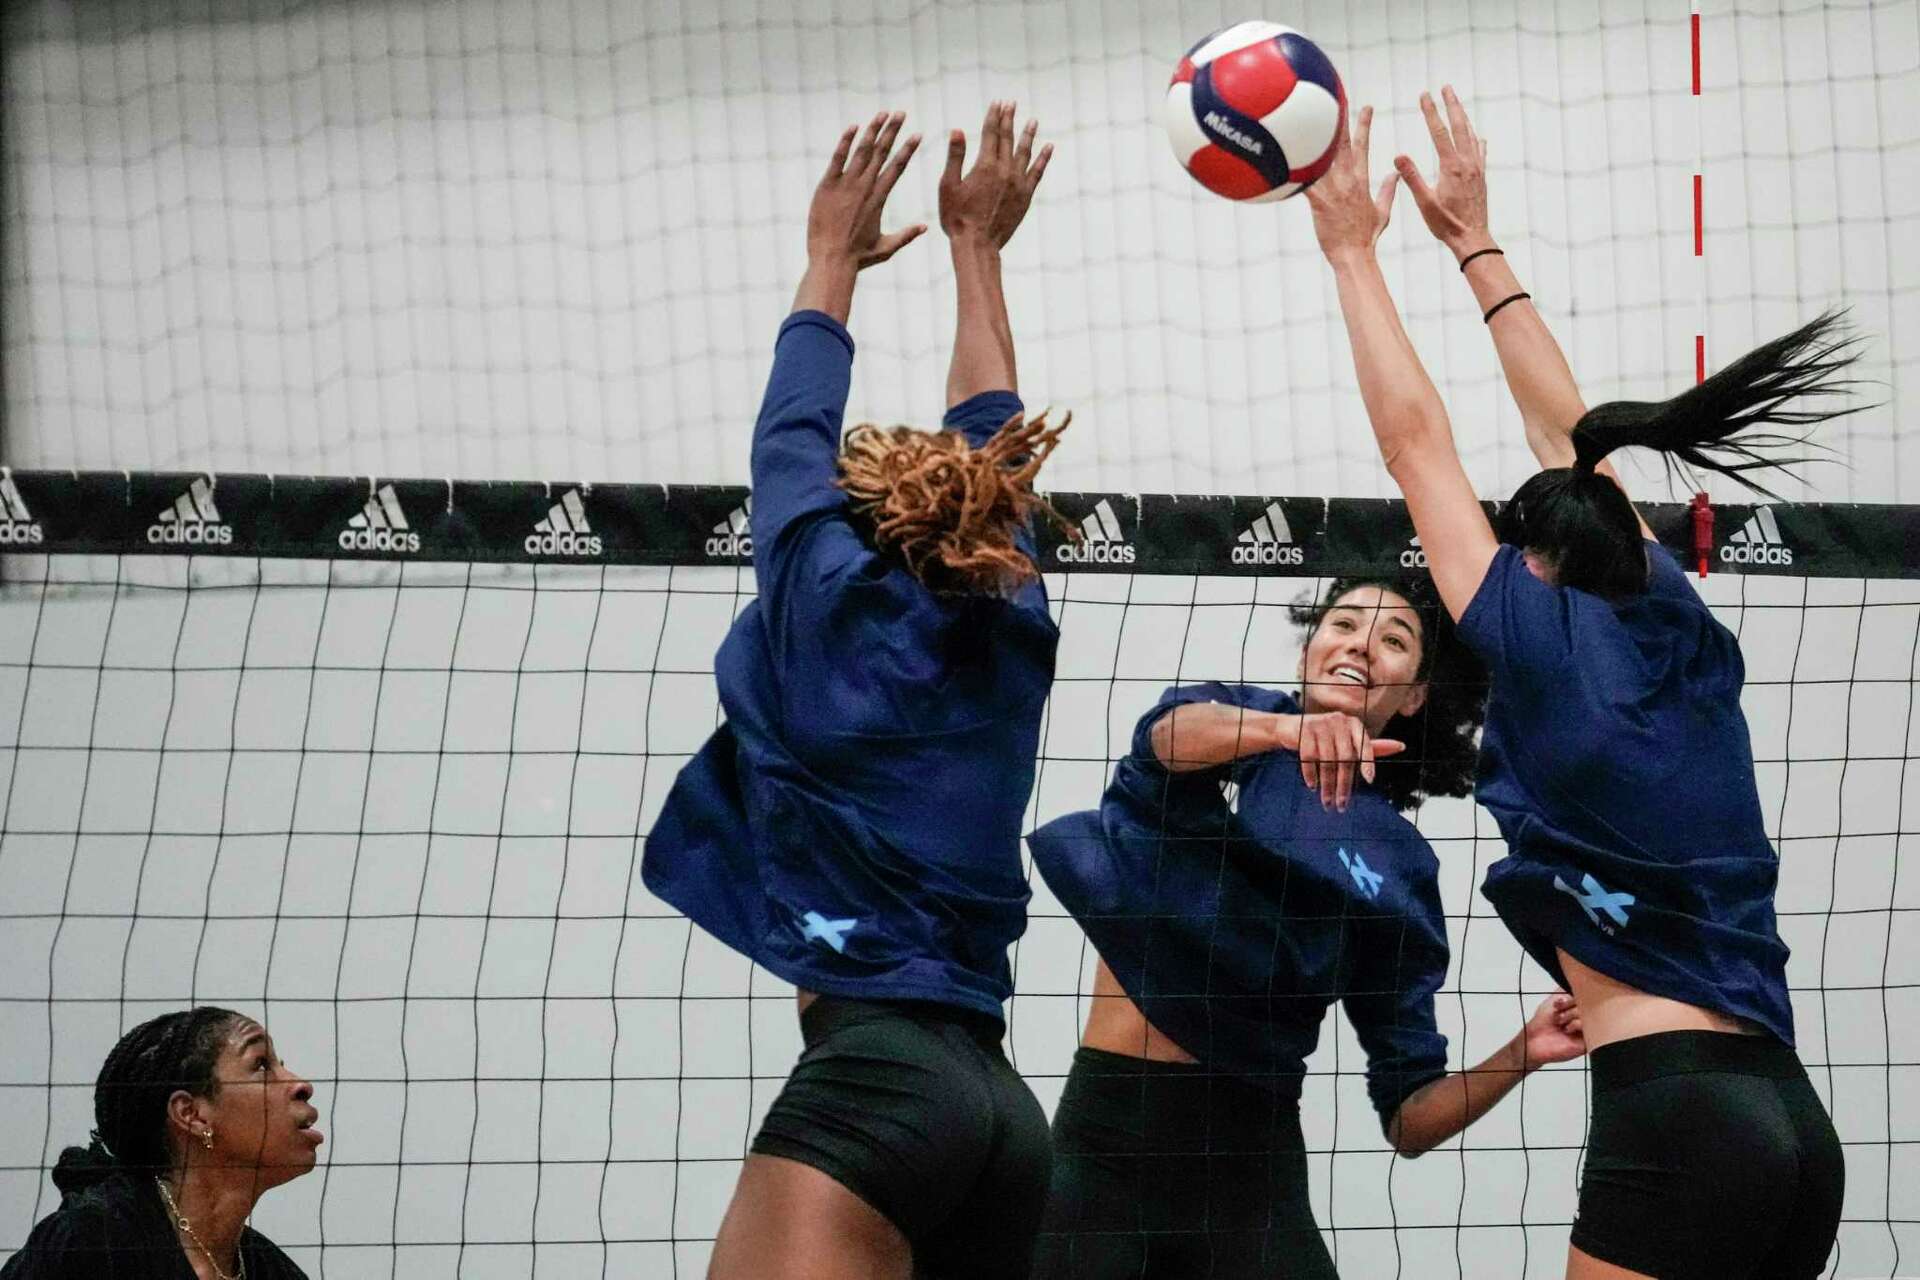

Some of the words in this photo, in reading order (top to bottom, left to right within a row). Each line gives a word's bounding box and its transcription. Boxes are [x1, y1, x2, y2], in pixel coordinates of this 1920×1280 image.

[0, 519, 43, 544] das
[147, 519, 233, 544] adidas
[338, 527, 421, 553] adidas
[524, 531, 602, 555] adidas
[705, 533, 754, 556] adid
[1056, 540, 1136, 563] adidas
[1231, 541, 1304, 565] adidas
[1720, 541, 1793, 565] adidas
